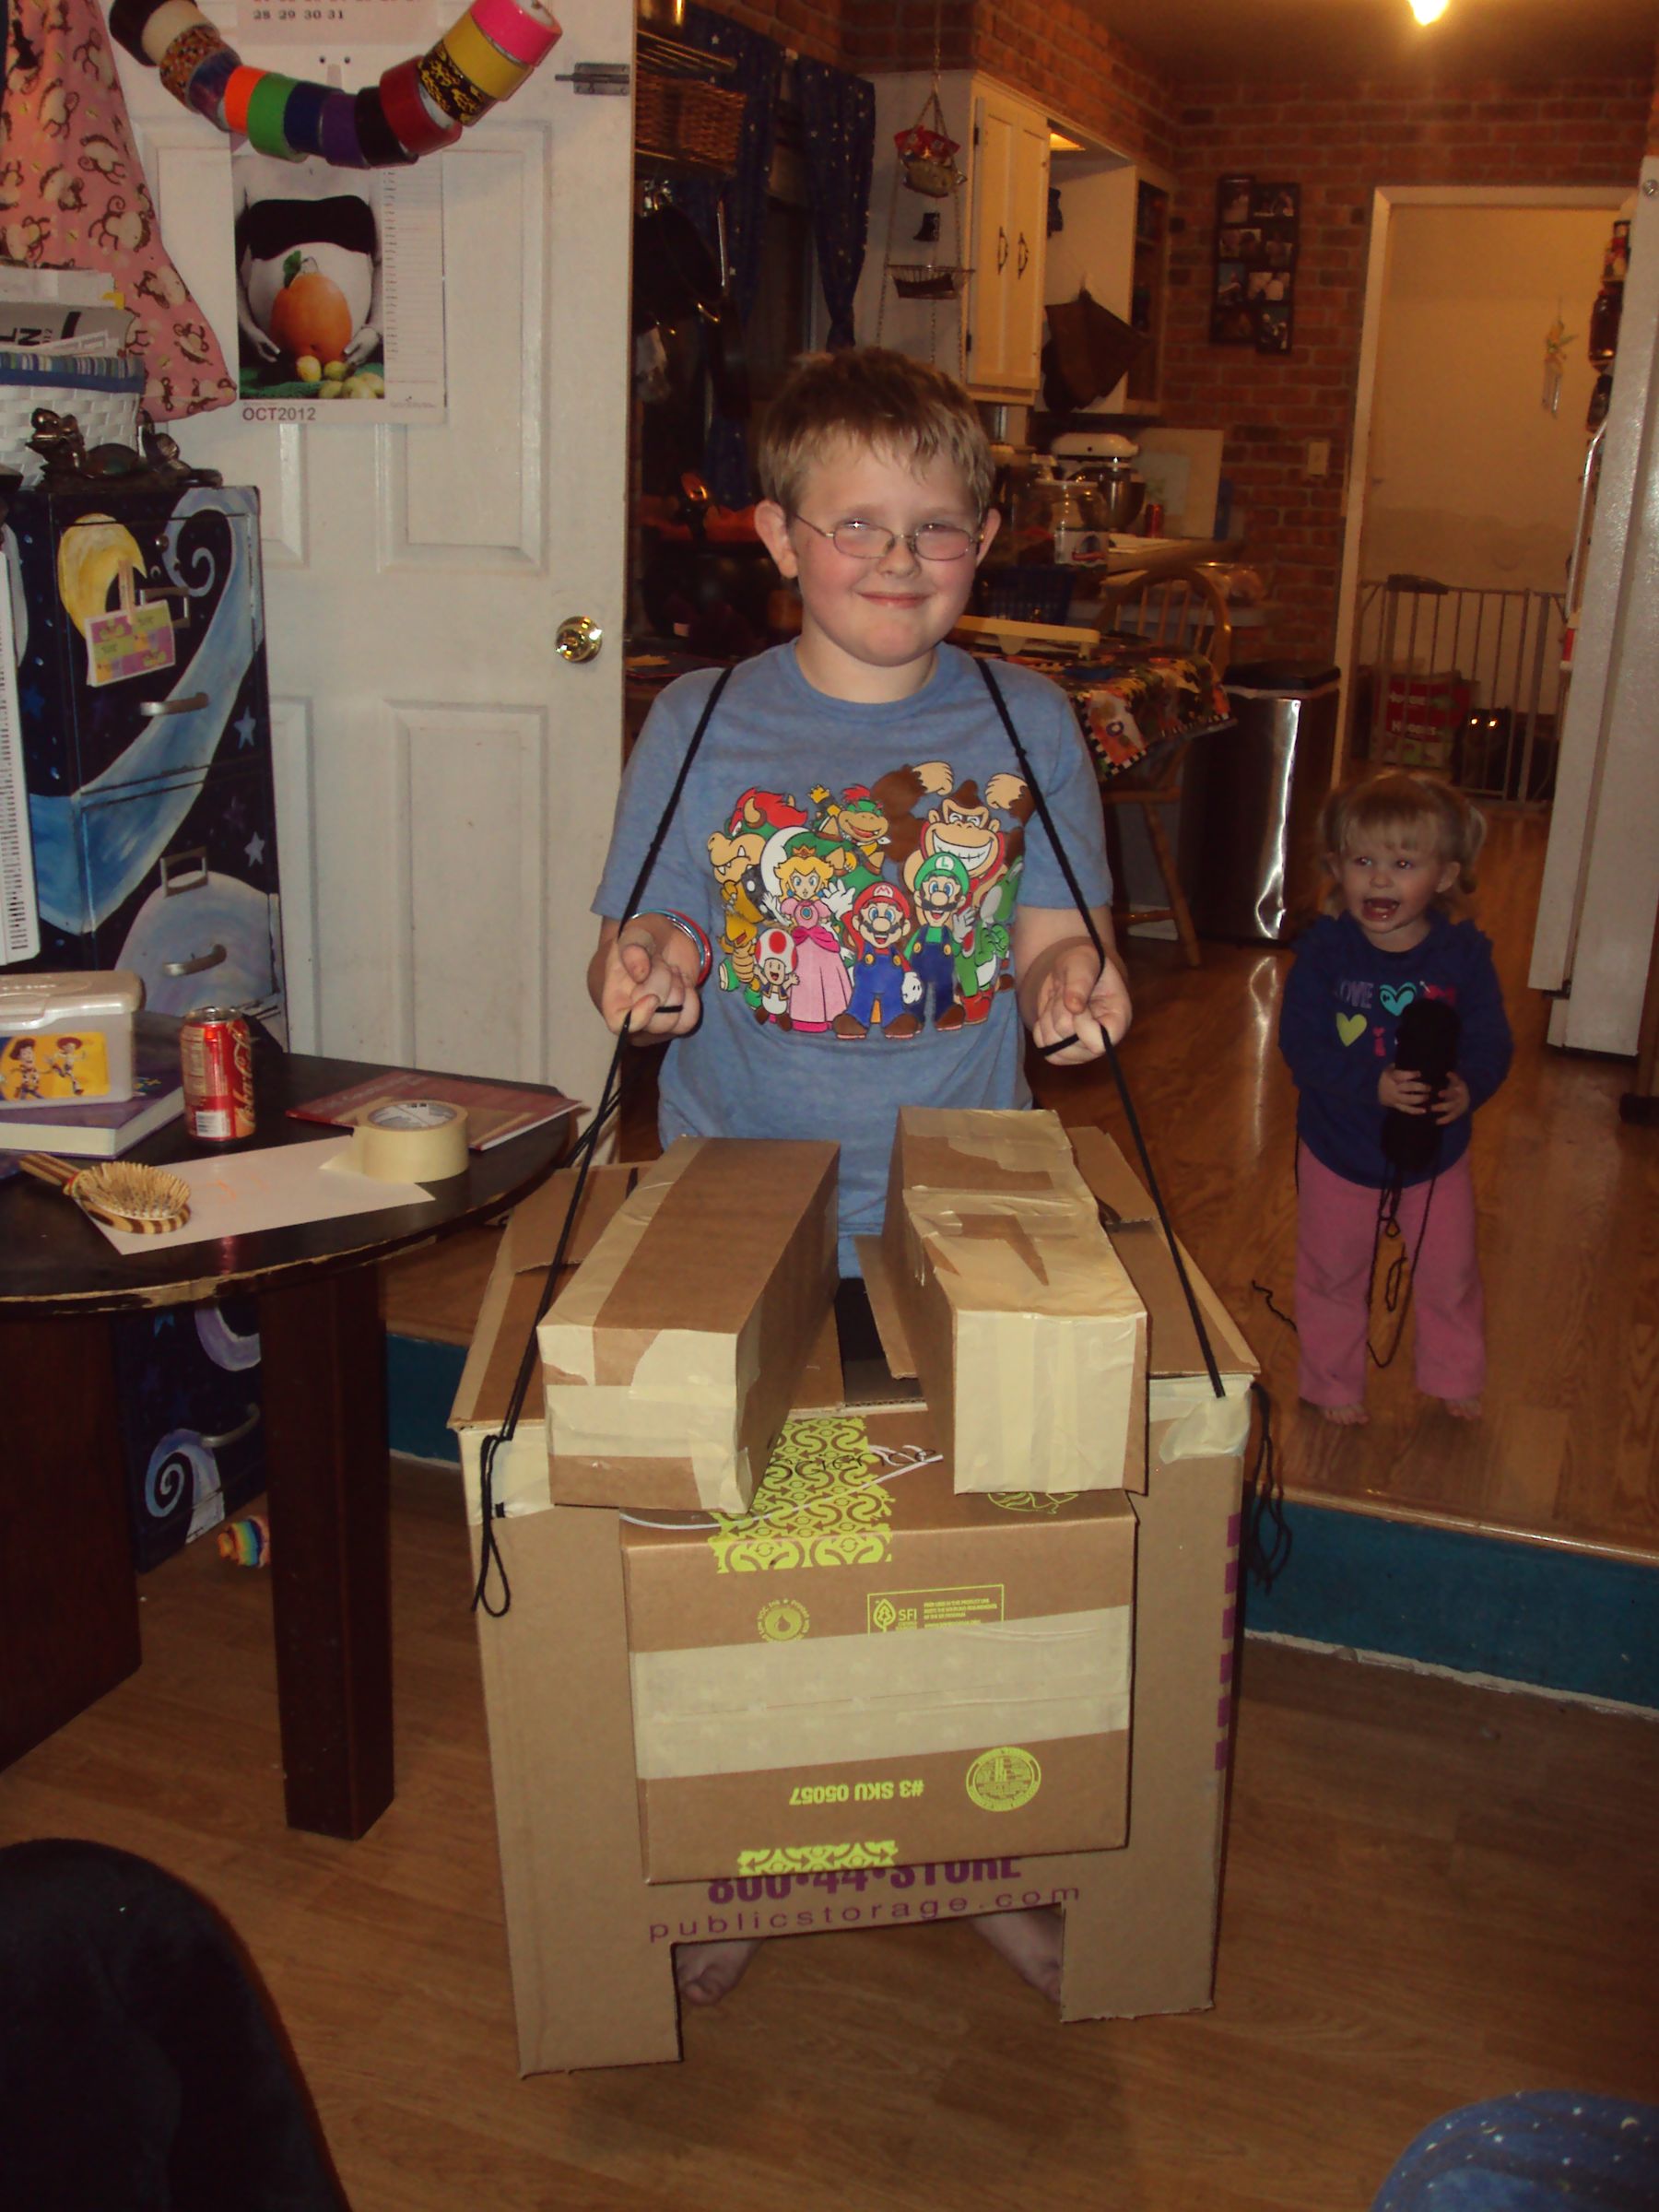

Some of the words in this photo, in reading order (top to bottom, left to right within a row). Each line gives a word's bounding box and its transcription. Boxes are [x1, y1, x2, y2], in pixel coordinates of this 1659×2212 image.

[253, 9, 271, 19] 28
[278, 9, 296, 19] 29
[304, 9, 322, 19] 30
[327, 9, 344, 19] 31
[242, 407, 316, 421] OCT2012
[1339, 980, 1374, 1009] OVE
[898, 1607, 918, 1621] SFI
[788, 1783, 850, 1806] 05057
[853, 1781, 895, 1801] SKU
[899, 1780, 925, 1798] #3
[649, 1885, 1080, 1944] publicstorage.com
